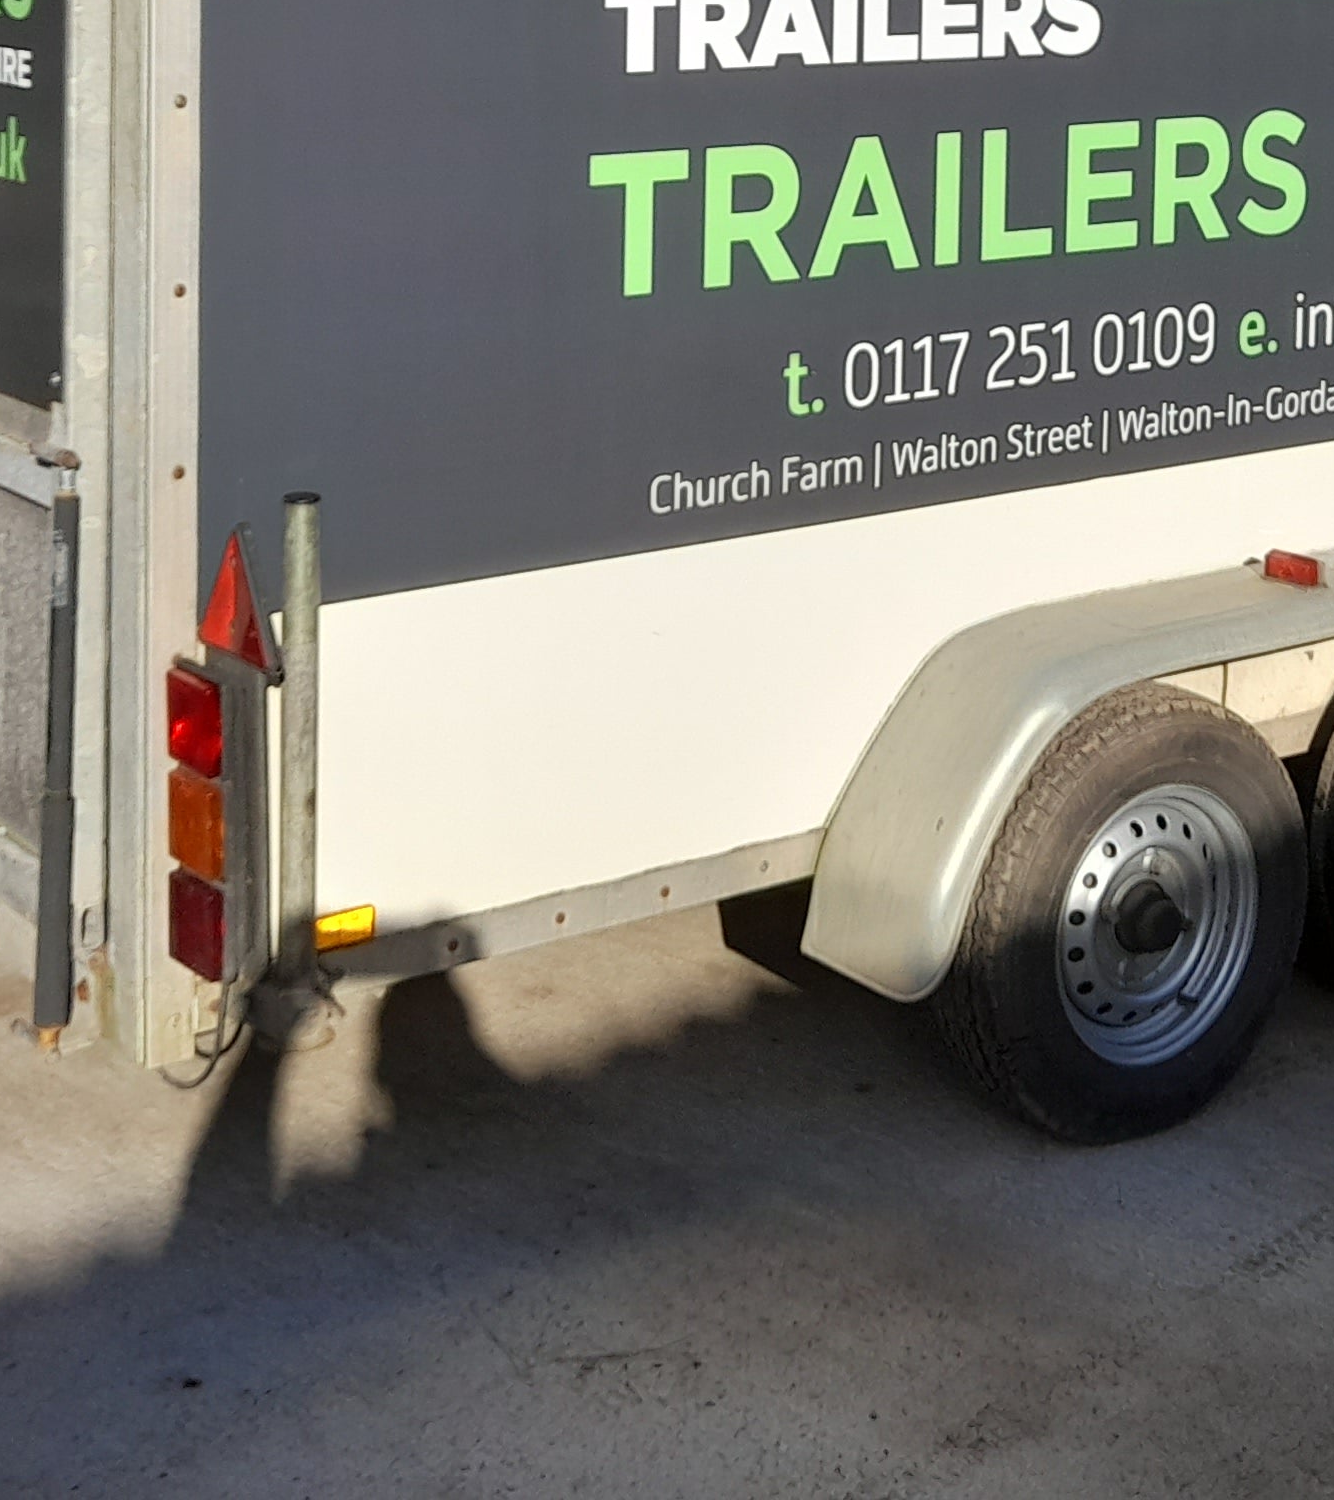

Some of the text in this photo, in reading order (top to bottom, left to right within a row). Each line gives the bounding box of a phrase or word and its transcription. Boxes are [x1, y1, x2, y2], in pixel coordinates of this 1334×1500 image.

[588, 108, 1307, 298] TRAILERS
[782, 352, 826, 418] t.
[843, 330, 970, 410] 0117
[985, 318, 1078, 392] 251
[1092, 302, 1217, 376] 0109
[1238, 309, 1278, 358] e.
[650, 461, 769, 516] Church
[780, 450, 864, 496] Farm
[891, 427, 997, 478] Walton
[1006, 414, 1094, 461] Street
